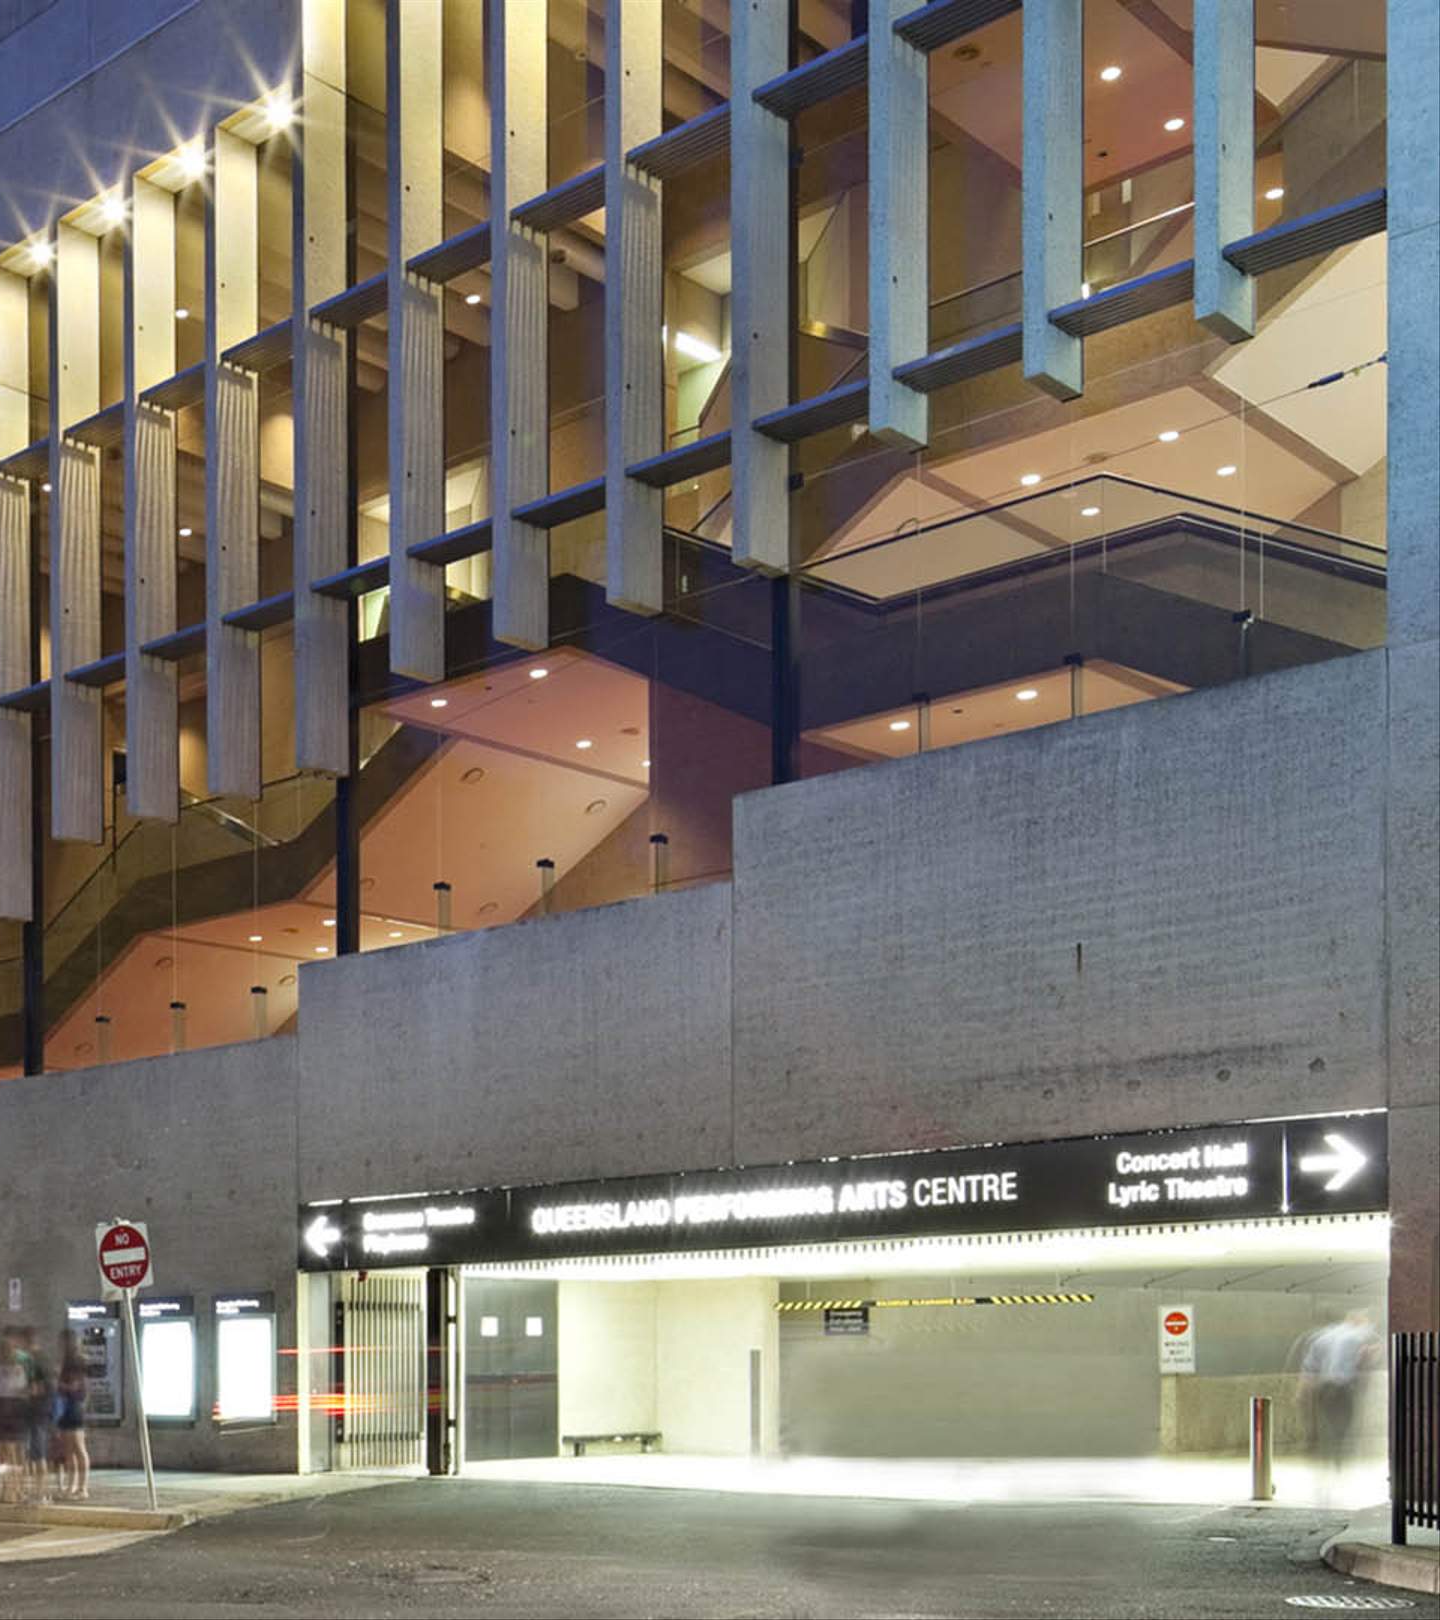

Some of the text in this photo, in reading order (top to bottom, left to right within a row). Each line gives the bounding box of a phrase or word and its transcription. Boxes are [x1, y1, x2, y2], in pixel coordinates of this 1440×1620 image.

[1116, 1141, 1249, 1175] Concert Hall
[531, 1198, 672, 1235] QUEENSLAND
[837, 1180, 908, 1213] ARTS
[913, 1172, 1018, 1207] CENTRE
[1108, 1175, 1249, 1208] Lyric Theatre
[114, 1232, 130, 1246] NO
[110, 1264, 142, 1280] ENTRY
